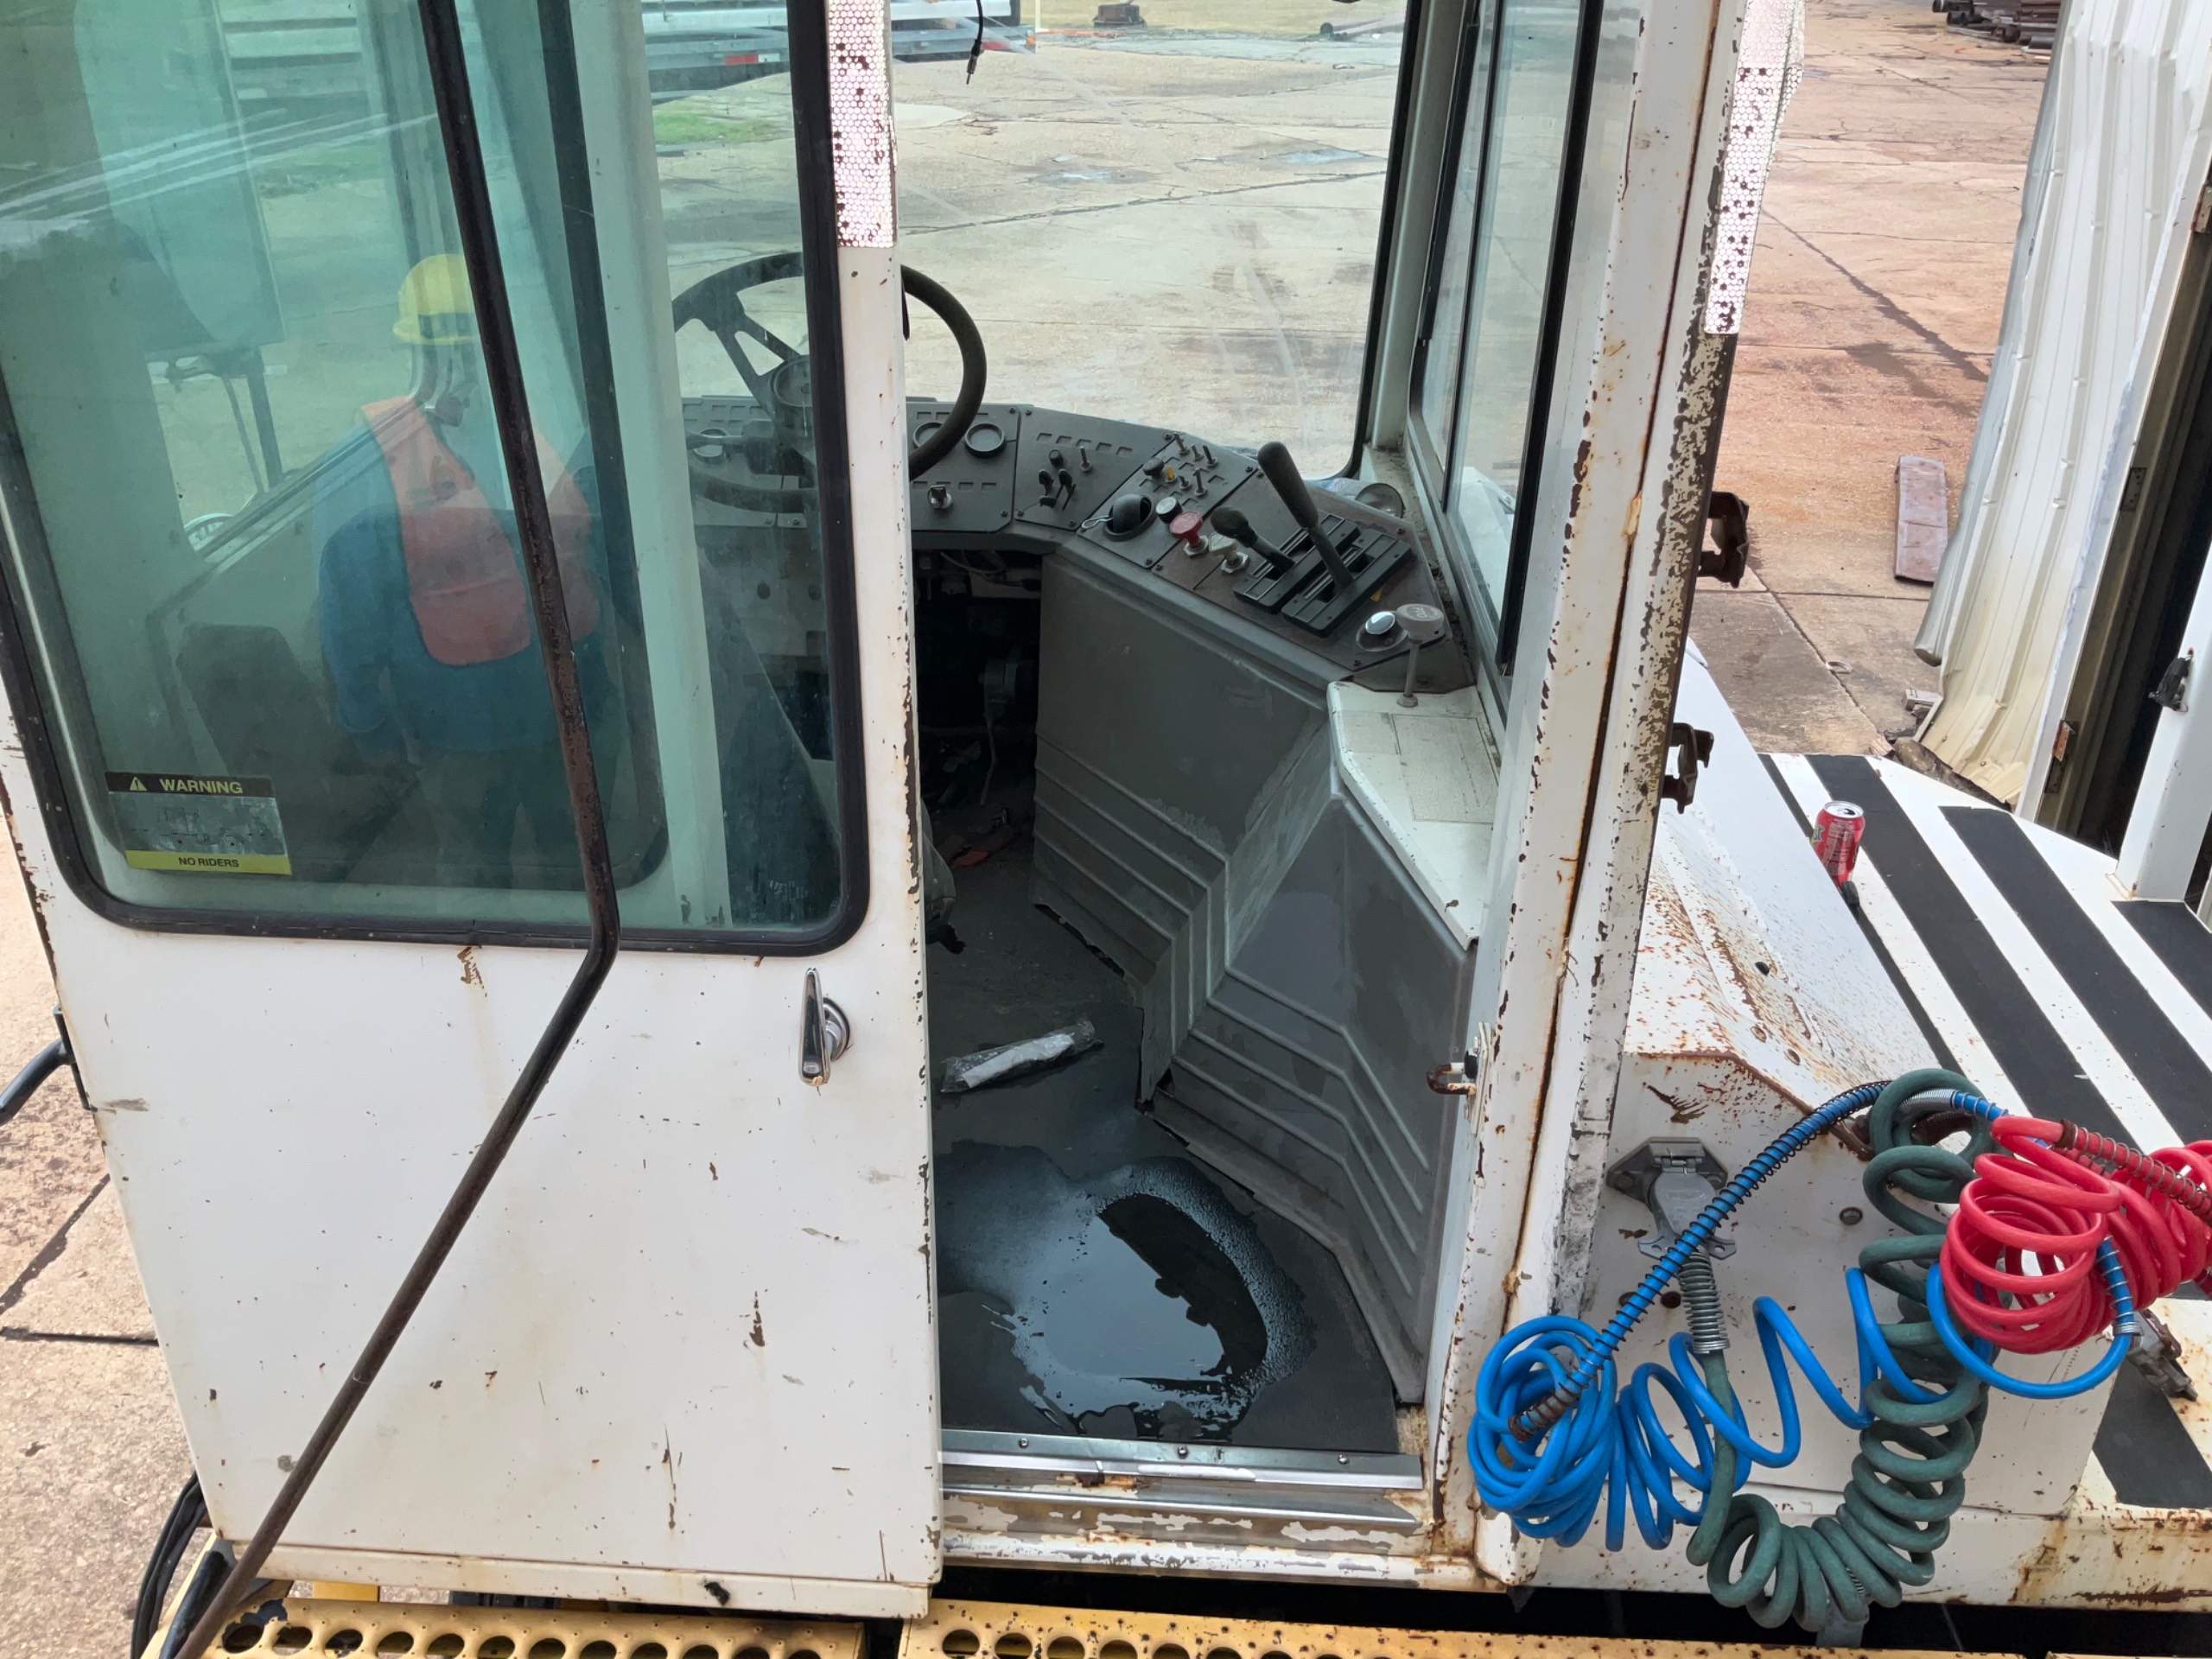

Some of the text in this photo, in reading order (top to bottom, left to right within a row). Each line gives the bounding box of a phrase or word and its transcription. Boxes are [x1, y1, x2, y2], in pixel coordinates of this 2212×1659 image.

[159, 779, 243, 793] WARNING
[178, 857, 239, 868] NO RIDERS
